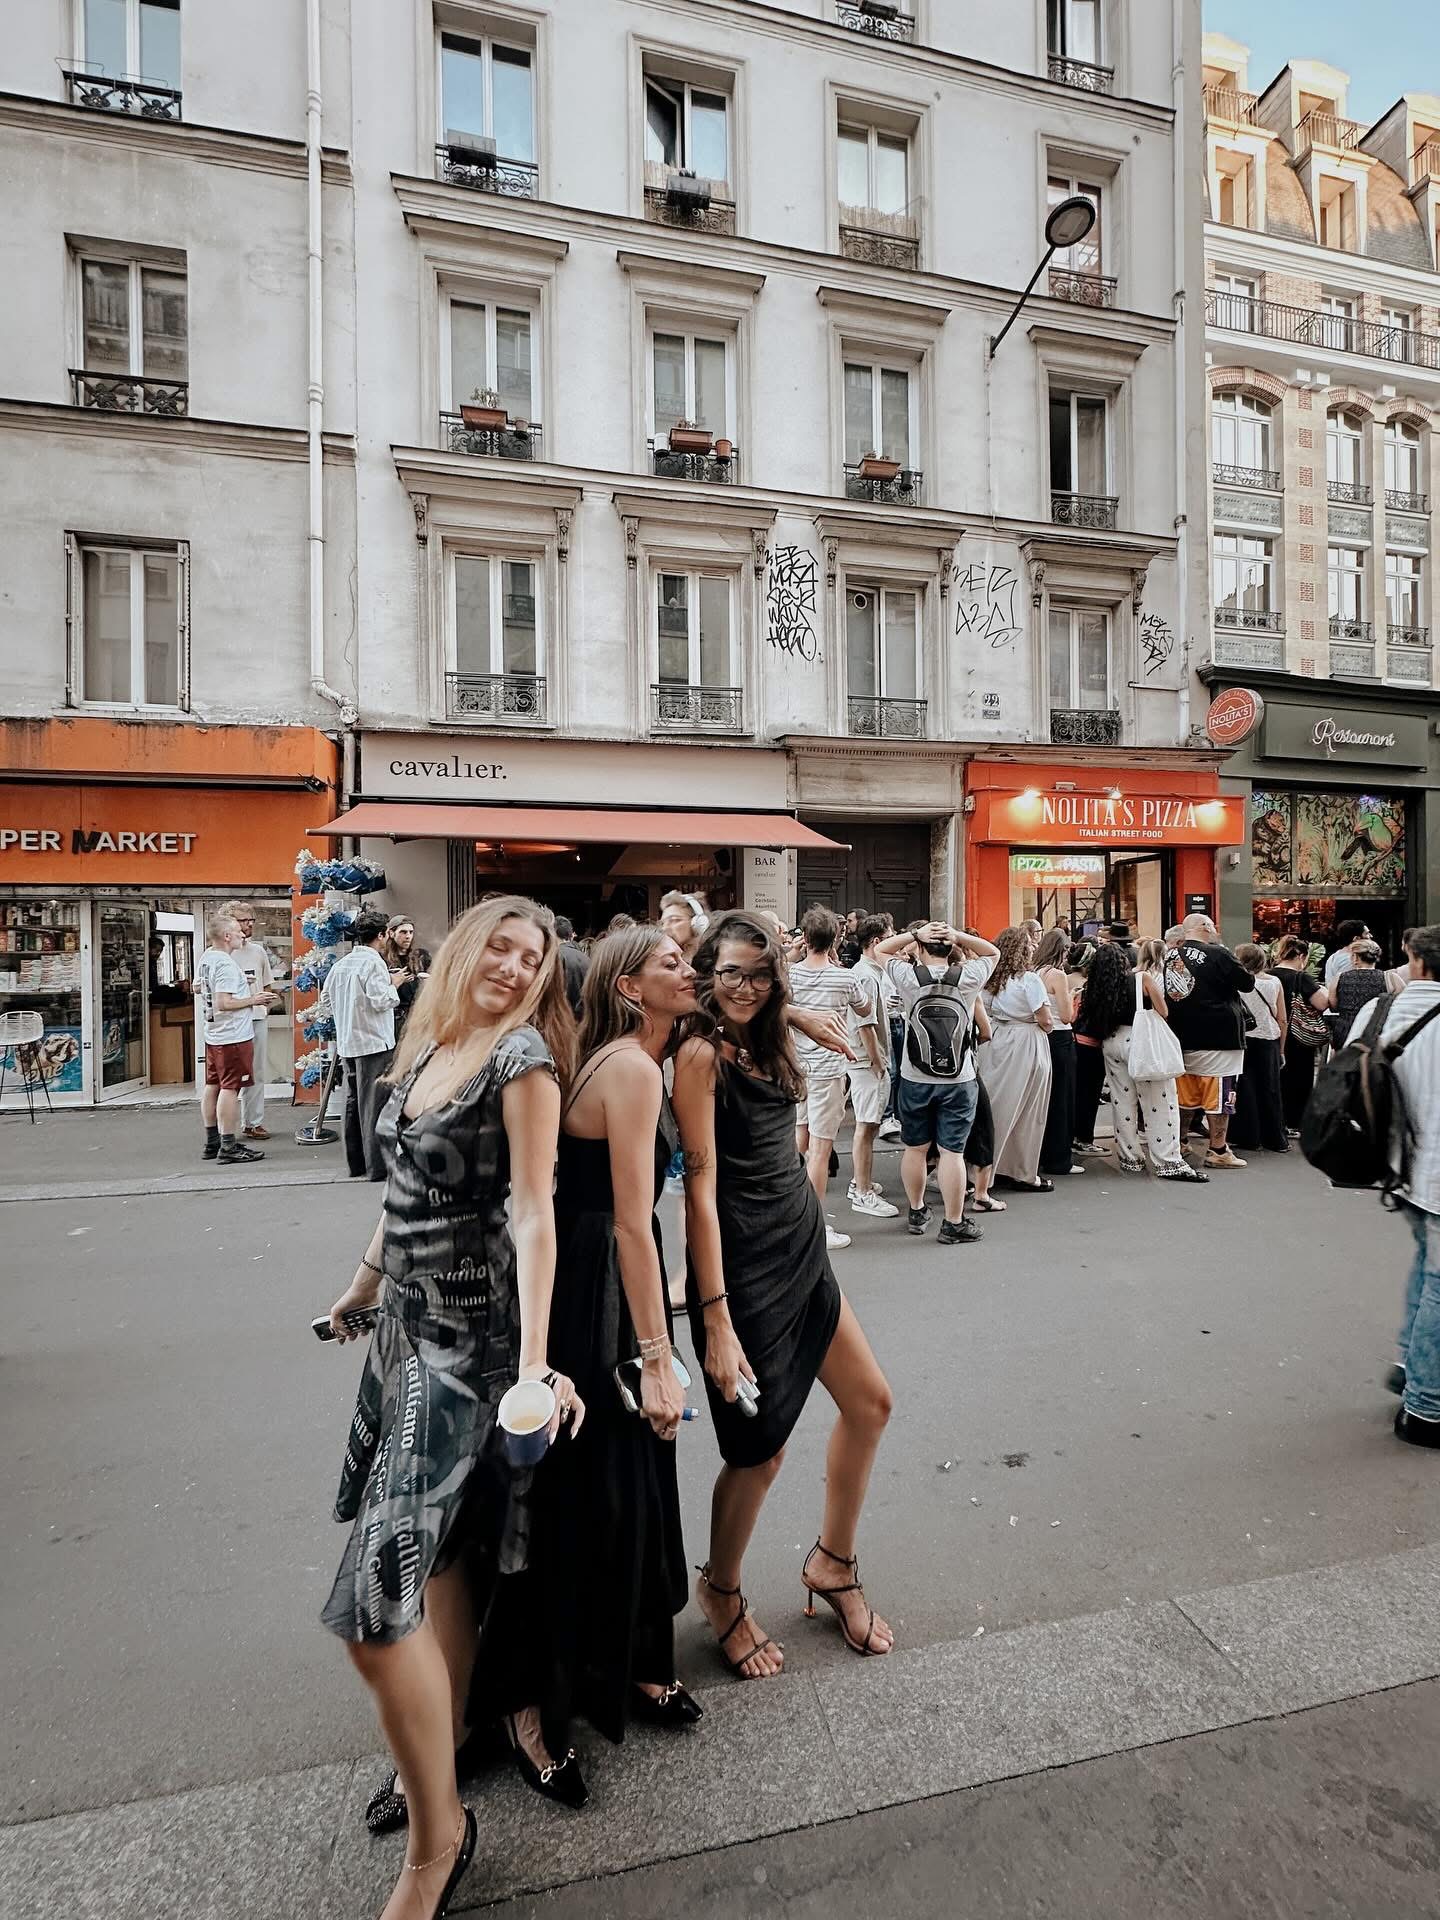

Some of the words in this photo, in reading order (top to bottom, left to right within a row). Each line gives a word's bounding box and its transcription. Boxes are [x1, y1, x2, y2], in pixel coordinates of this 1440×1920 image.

[983, 694, 1000, 707] 22
[1211, 707, 1249, 726] NOLITA'S
[1312, 717, 1396, 753] Restaurant
[1041, 797, 1135, 827] NOLITA'S
[1141, 800, 1198, 829] PIZZA
[0, 829, 62, 851] PER
[71, 829, 197, 855] MARKET
[1079, 828, 1109, 838] ITALIAN
[1111, 829, 1141, 839] STREET
[1142, 830, 1164, 839] FOOD
[754, 857, 776, 866] BAR
[1016, 856, 1054, 872] PIZZA
[1063, 857, 1103, 873] PASTA
[401, 1354, 422, 1450] galliano
[391, 1514, 422, 1614] galliano
